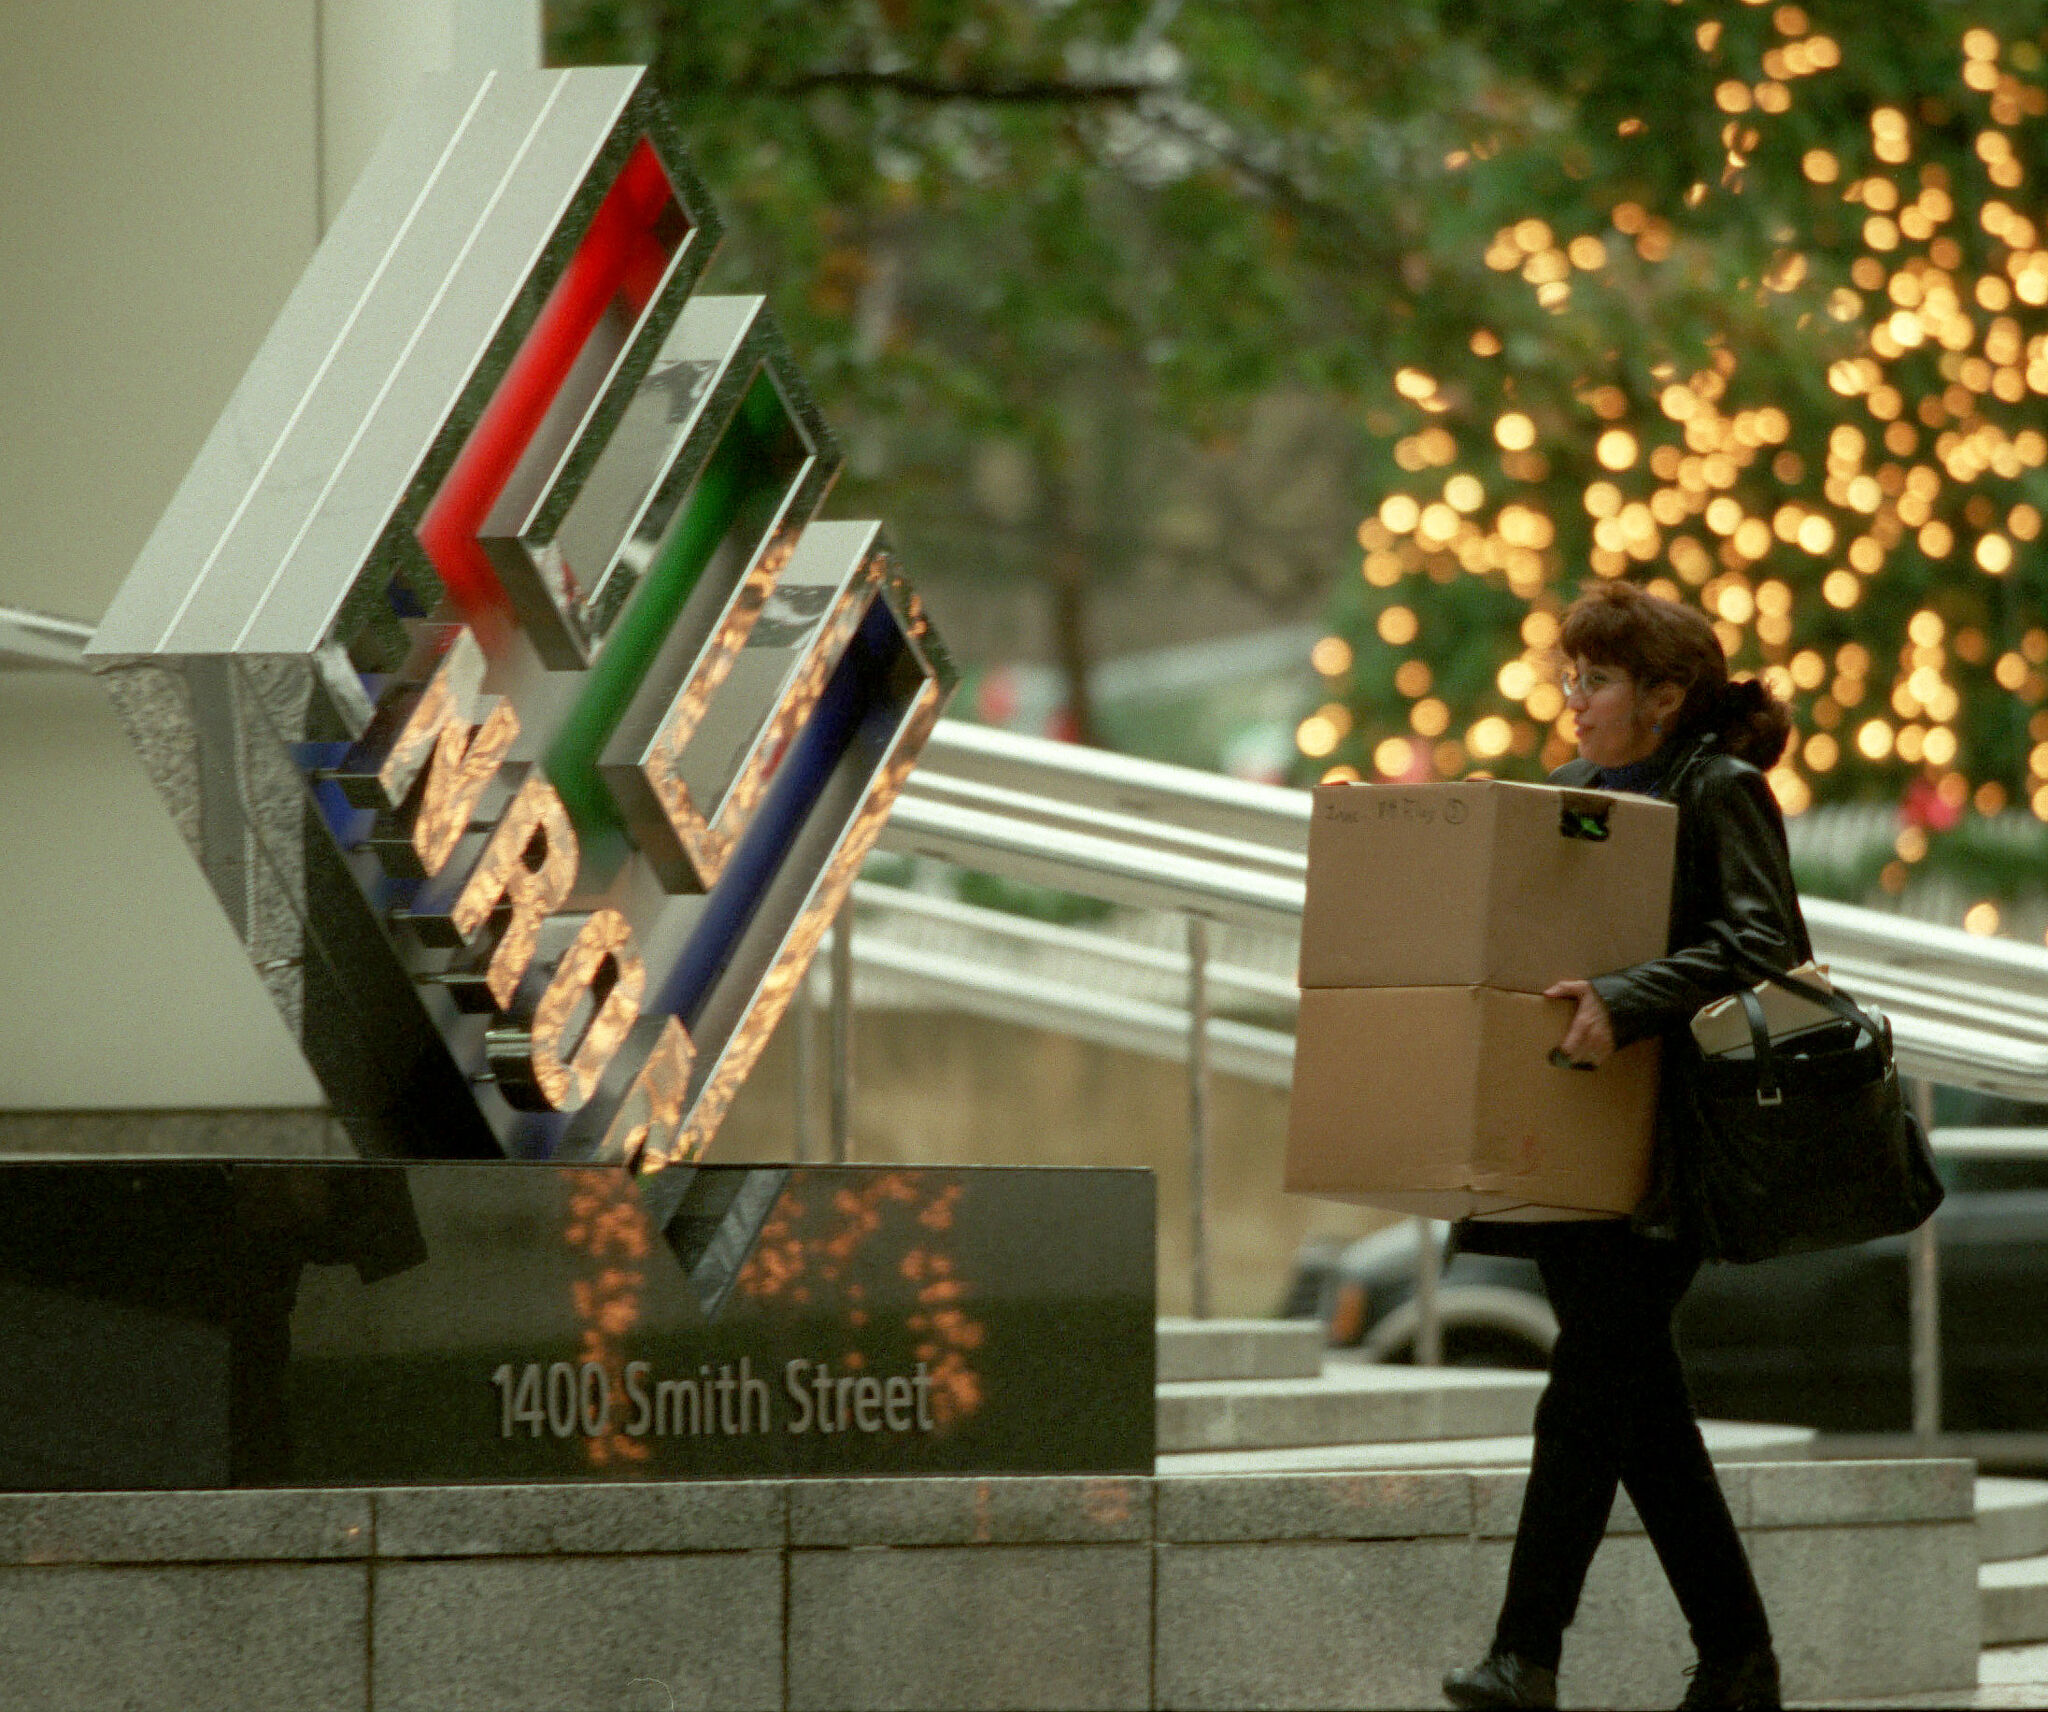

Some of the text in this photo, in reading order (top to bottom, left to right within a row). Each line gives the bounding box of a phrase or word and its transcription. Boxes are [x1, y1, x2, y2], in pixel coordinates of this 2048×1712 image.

[493, 1356, 936, 1438] 1400 Smith Street
